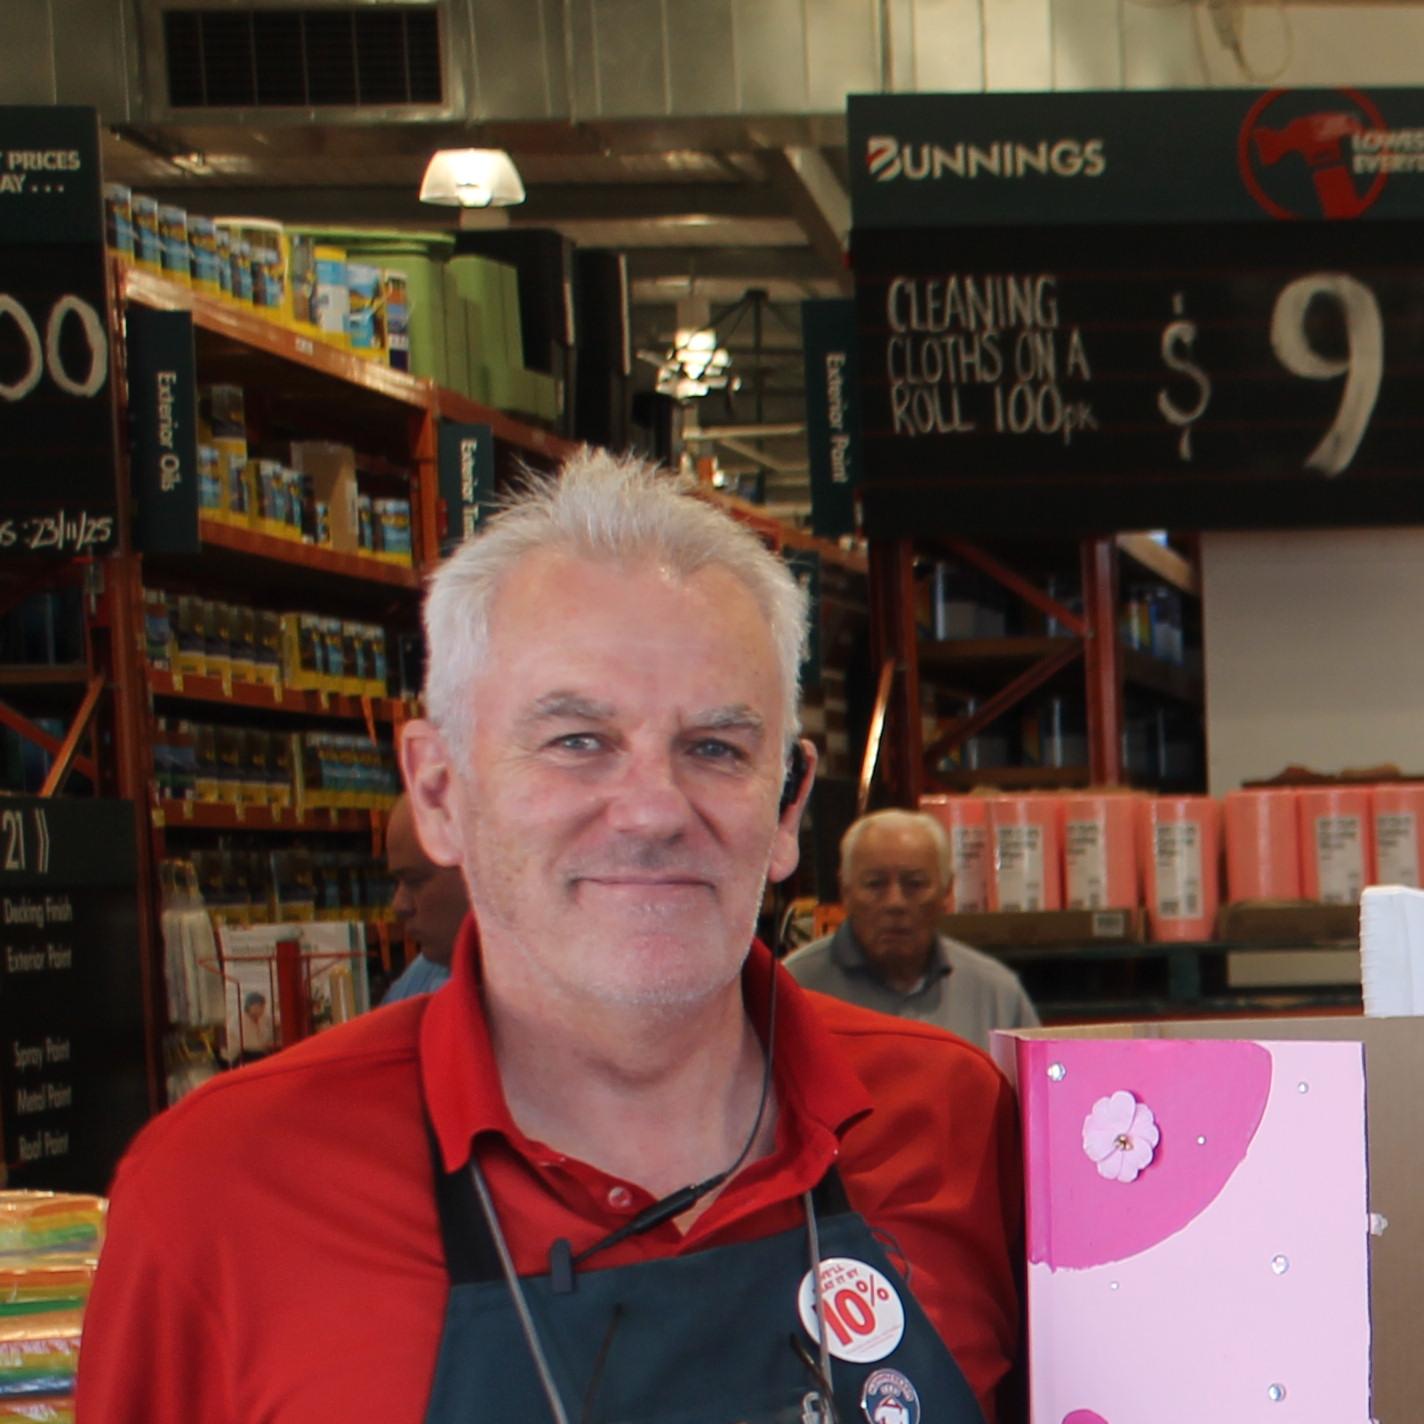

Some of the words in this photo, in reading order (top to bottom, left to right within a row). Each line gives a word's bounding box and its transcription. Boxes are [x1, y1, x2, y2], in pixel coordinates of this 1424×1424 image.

[866, 135, 1106, 182] BUNNINGS
[887, 274, 1059, 333] CLEANING
[888, 330, 1002, 384] CLOTHS
[1015, 330, 1056, 382] ON
[1066, 327, 1092, 381] A
[1270, 271, 1384, 479] 9
[157, 371, 180, 449] Exterior
[891, 379, 977, 438] ROLL
[160, 453, 182, 492] Oils
[2, 809, 27, 871] 21
